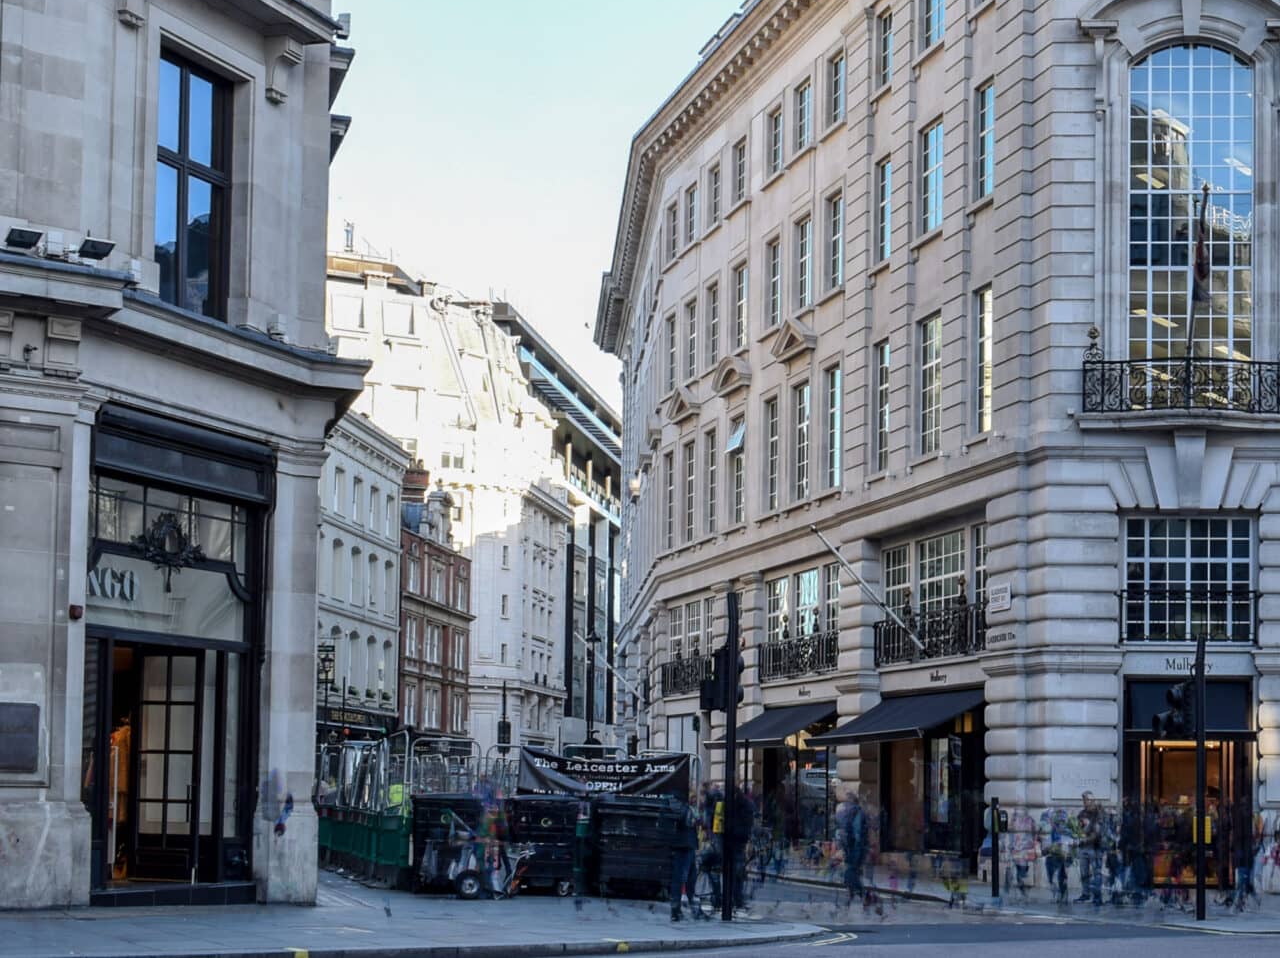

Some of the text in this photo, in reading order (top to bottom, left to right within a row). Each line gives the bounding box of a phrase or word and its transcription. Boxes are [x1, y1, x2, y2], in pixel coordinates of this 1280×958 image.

[534, 757, 676, 773] The Leicester Arms
[585, 781, 623, 792] OPEN!
